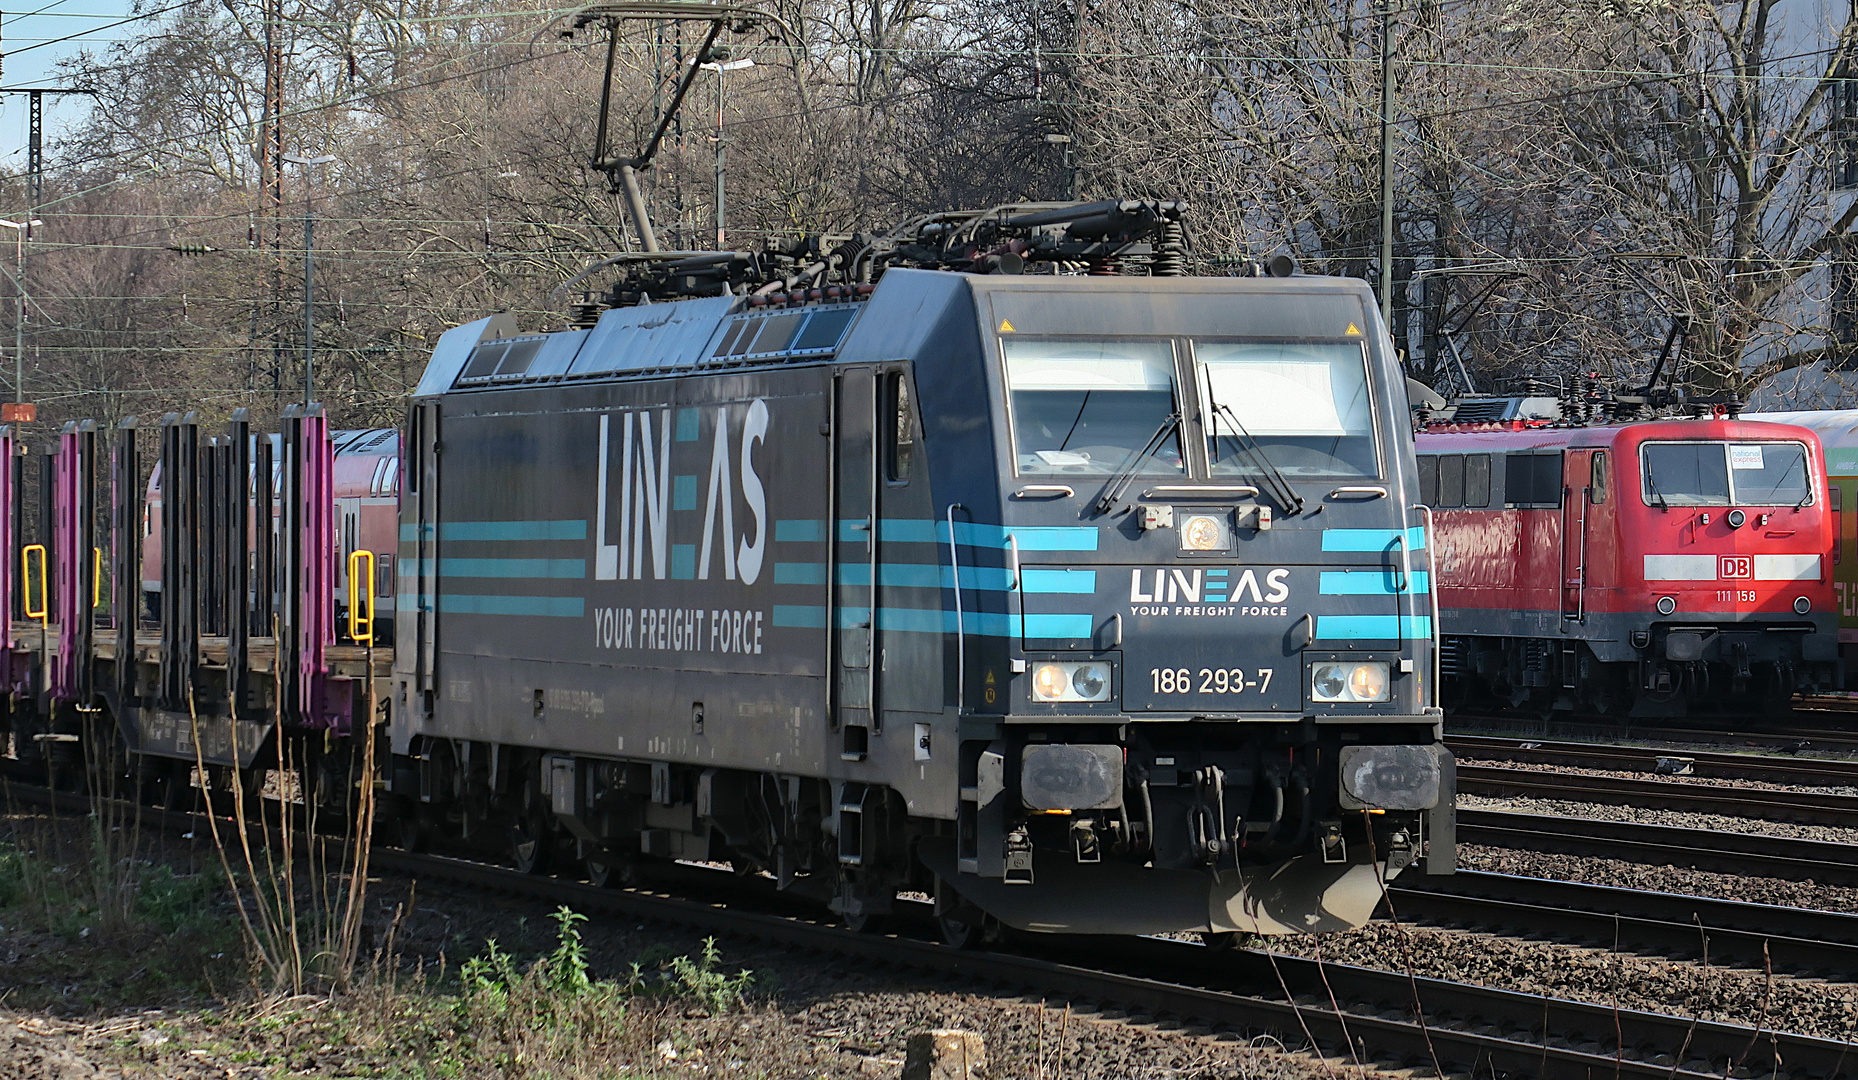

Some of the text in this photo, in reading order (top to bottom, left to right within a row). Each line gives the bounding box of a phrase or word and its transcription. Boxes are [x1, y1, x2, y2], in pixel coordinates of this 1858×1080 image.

[595, 399, 769, 585] LINEAS
[1723, 559, 1748, 576] DB
[1130, 568, 1290, 603] LINEAS
[1716, 590, 1756, 602] 111 158
[1130, 606, 1288, 616] YOUR FREIGHT FORCE
[594, 607, 763, 654] YOUR FREIGHT FORCE
[1150, 668, 1273, 694] 186 293-7
